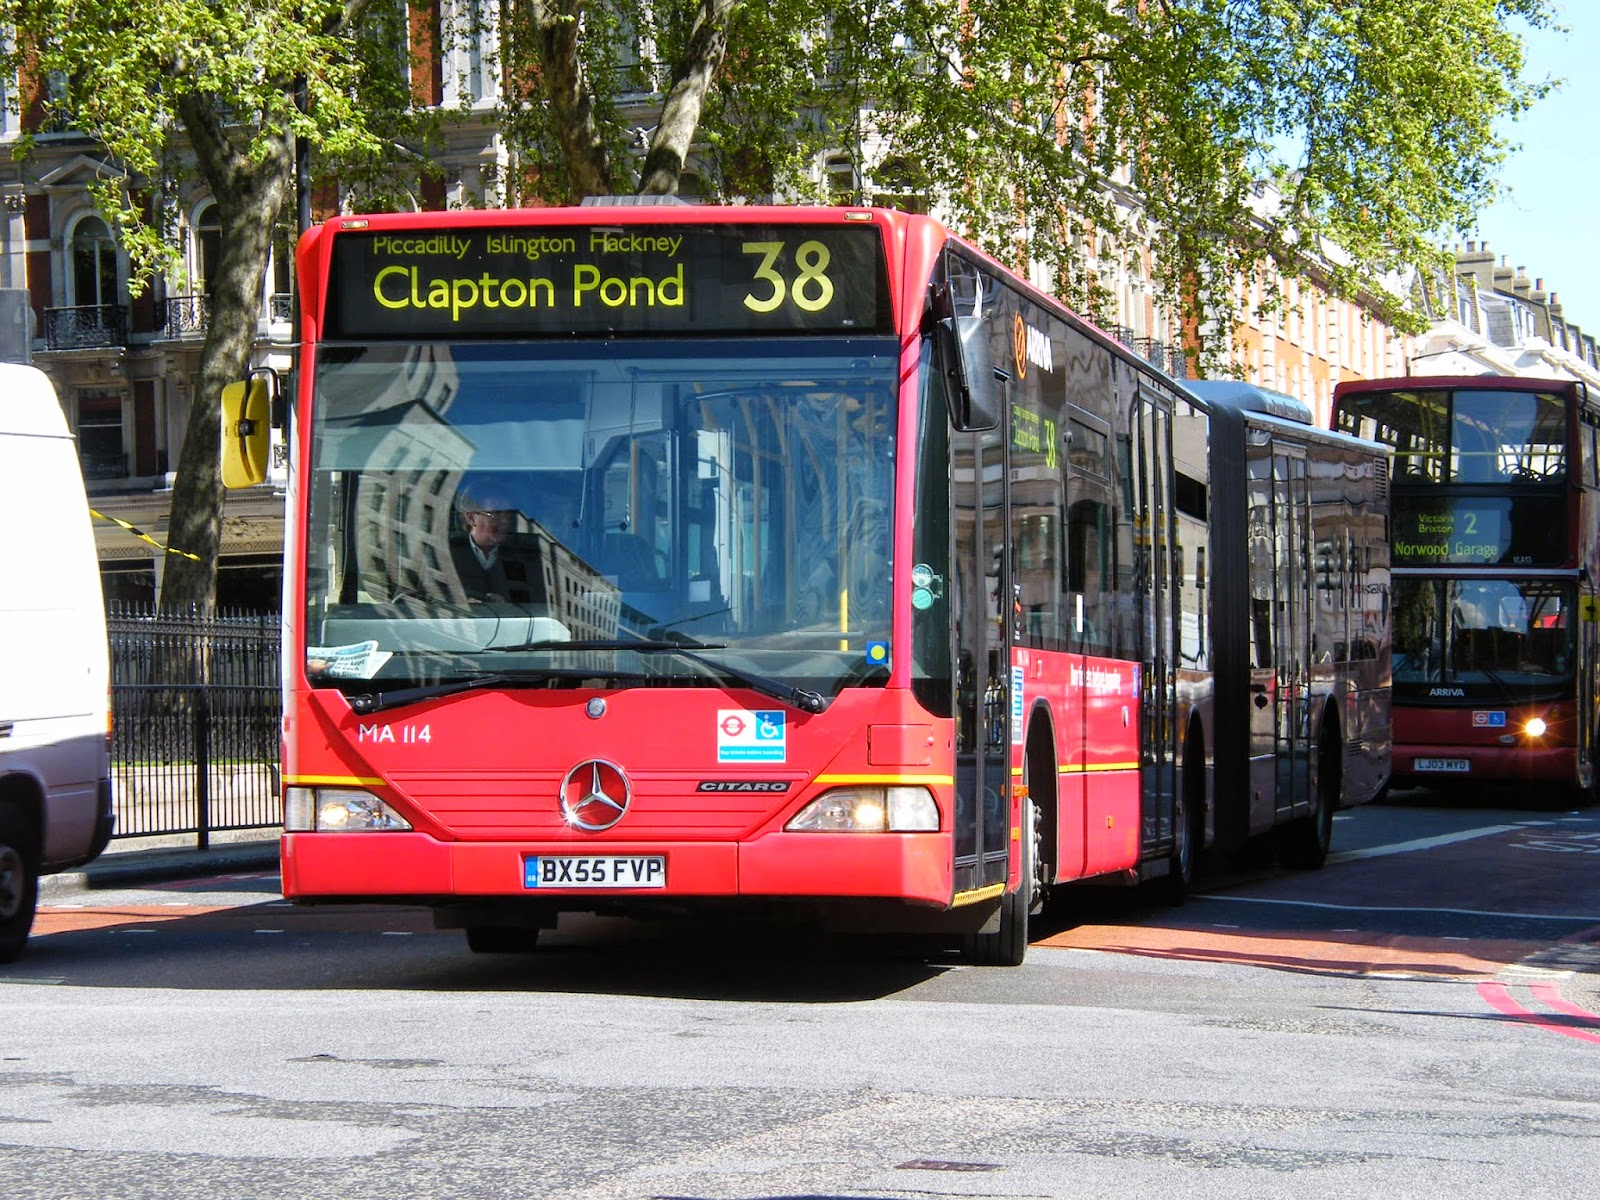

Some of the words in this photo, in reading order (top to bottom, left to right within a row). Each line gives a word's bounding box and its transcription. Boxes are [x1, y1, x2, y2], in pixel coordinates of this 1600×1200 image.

[373, 235, 471, 260] Piccadilly
[486, 234, 576, 261] Islington
[589, 233, 683, 257] Hackney
[742, 240, 834, 313] 38
[373, 265, 555, 321] Clapton
[573, 263, 684, 307] Pond
[1418, 513, 1454, 523] Victoria
[1463, 512, 1478, 534] 2
[1418, 524, 1453, 533] Brixton
[1395, 541, 1449, 556] Norwood
[1455, 541, 1498, 558] Garage
[1429, 688, 1465, 696] ARRIVA
[358, 723, 396, 743] MA
[403, 724, 432, 743] 114
[1418, 760, 1444, 769] LJ03
[700, 782, 787, 791] CITARO
[542, 859, 606, 882] BX55
[613, 859, 661, 882] FVP
